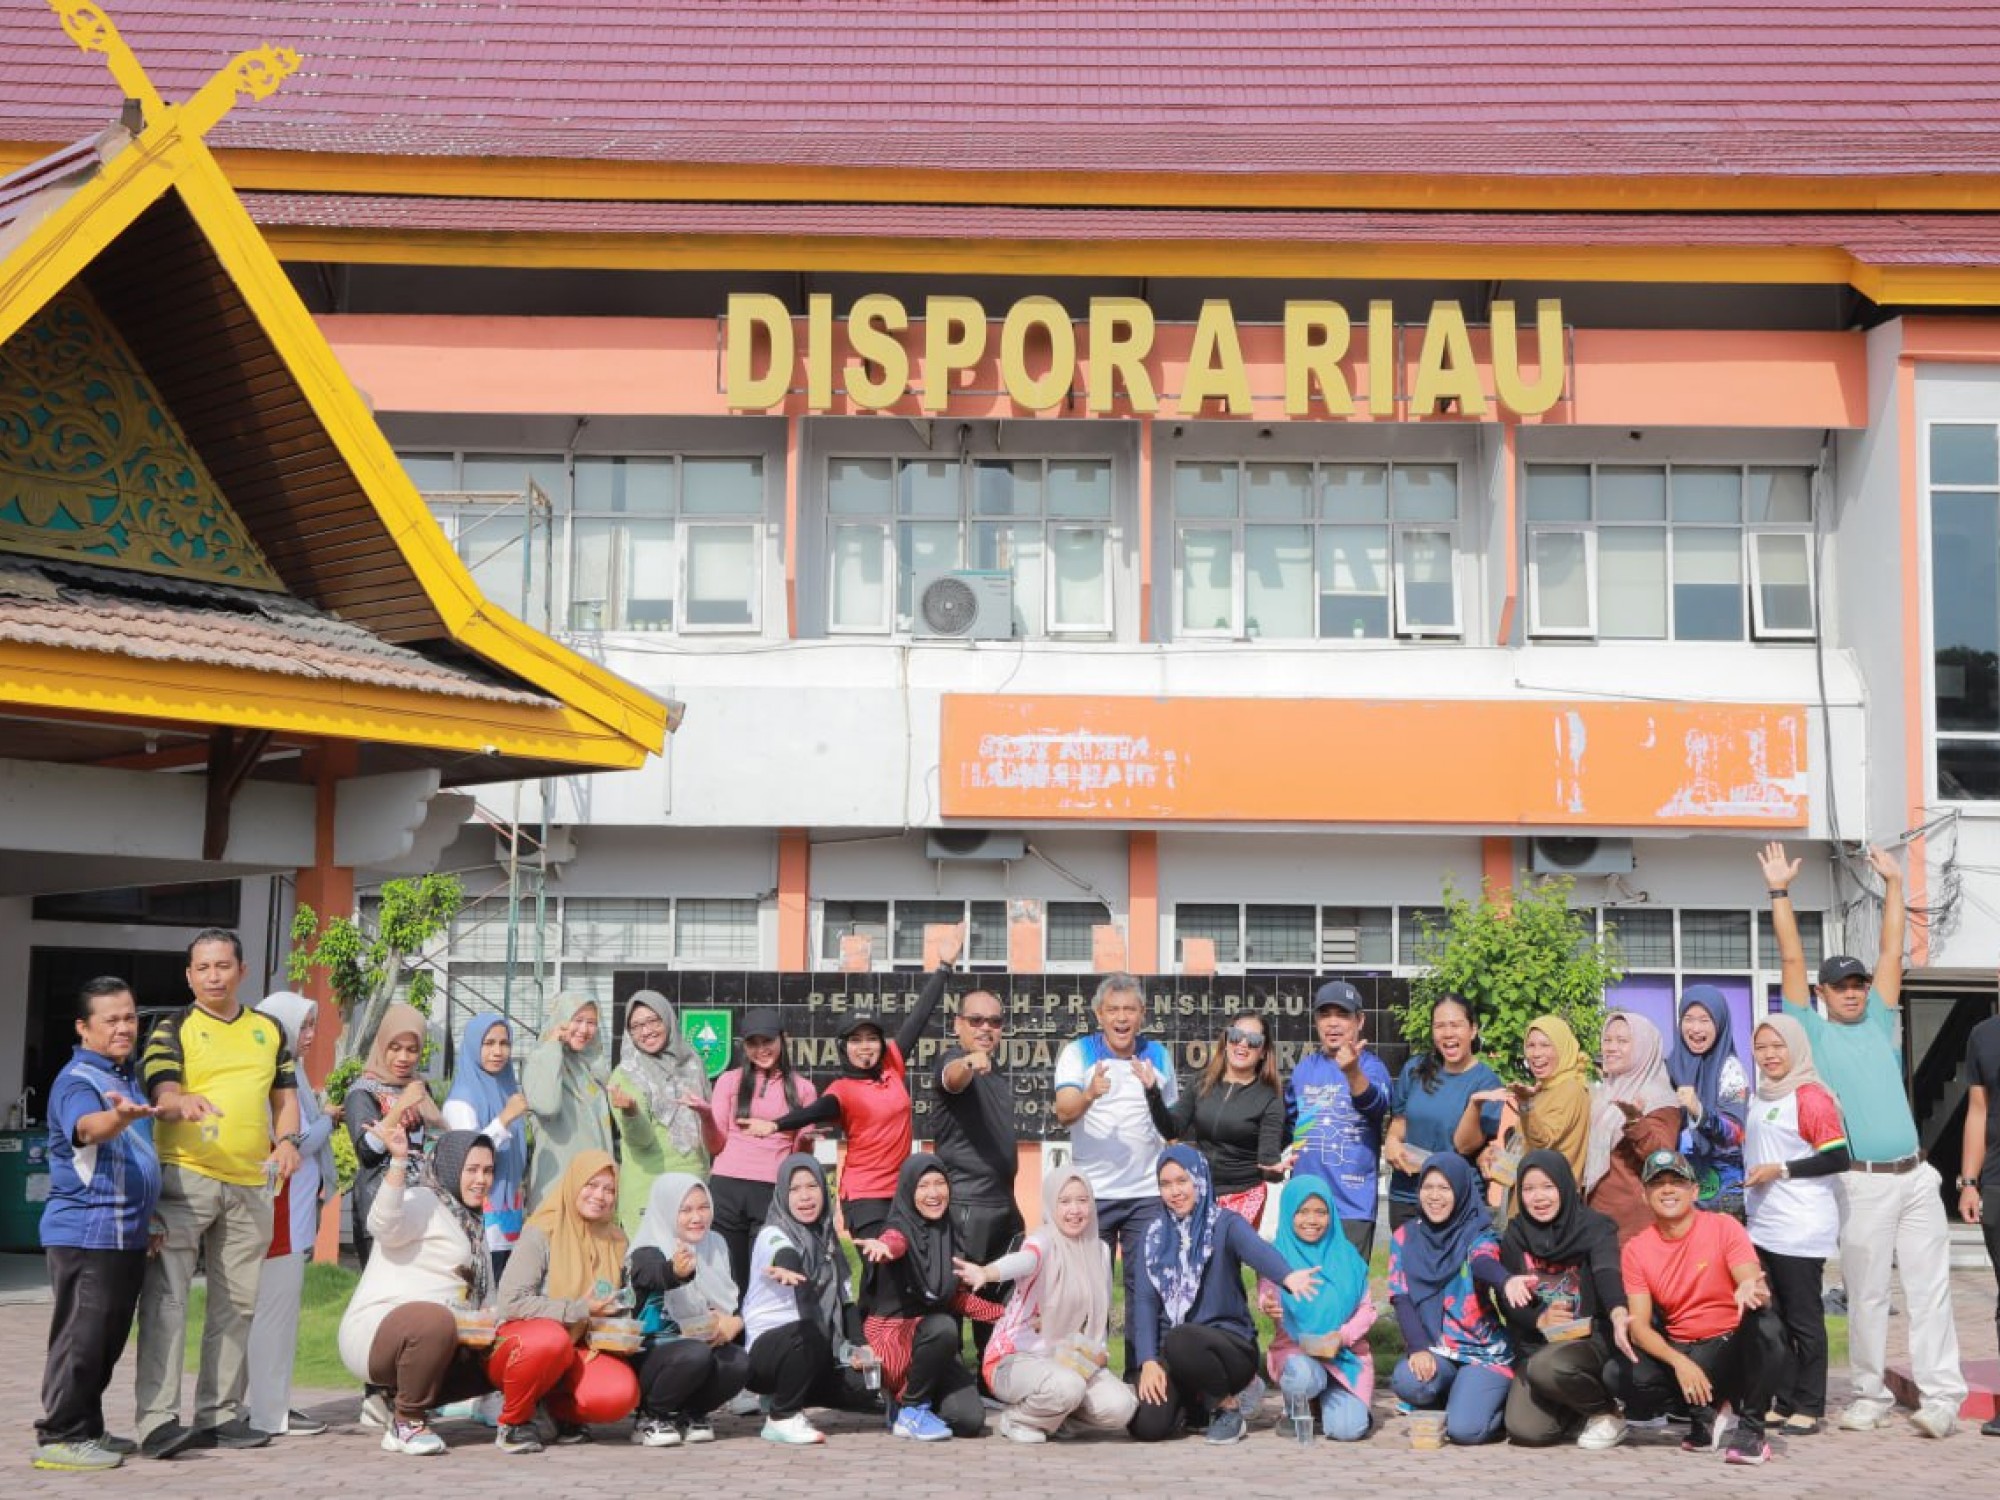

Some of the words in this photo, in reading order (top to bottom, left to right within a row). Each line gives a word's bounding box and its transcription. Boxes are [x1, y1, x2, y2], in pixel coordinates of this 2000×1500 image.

[726, 292, 1254, 417] DISPORA
[1283, 298, 1566, 418] RIAU
[1224, 994, 1303, 1016] RIAU
